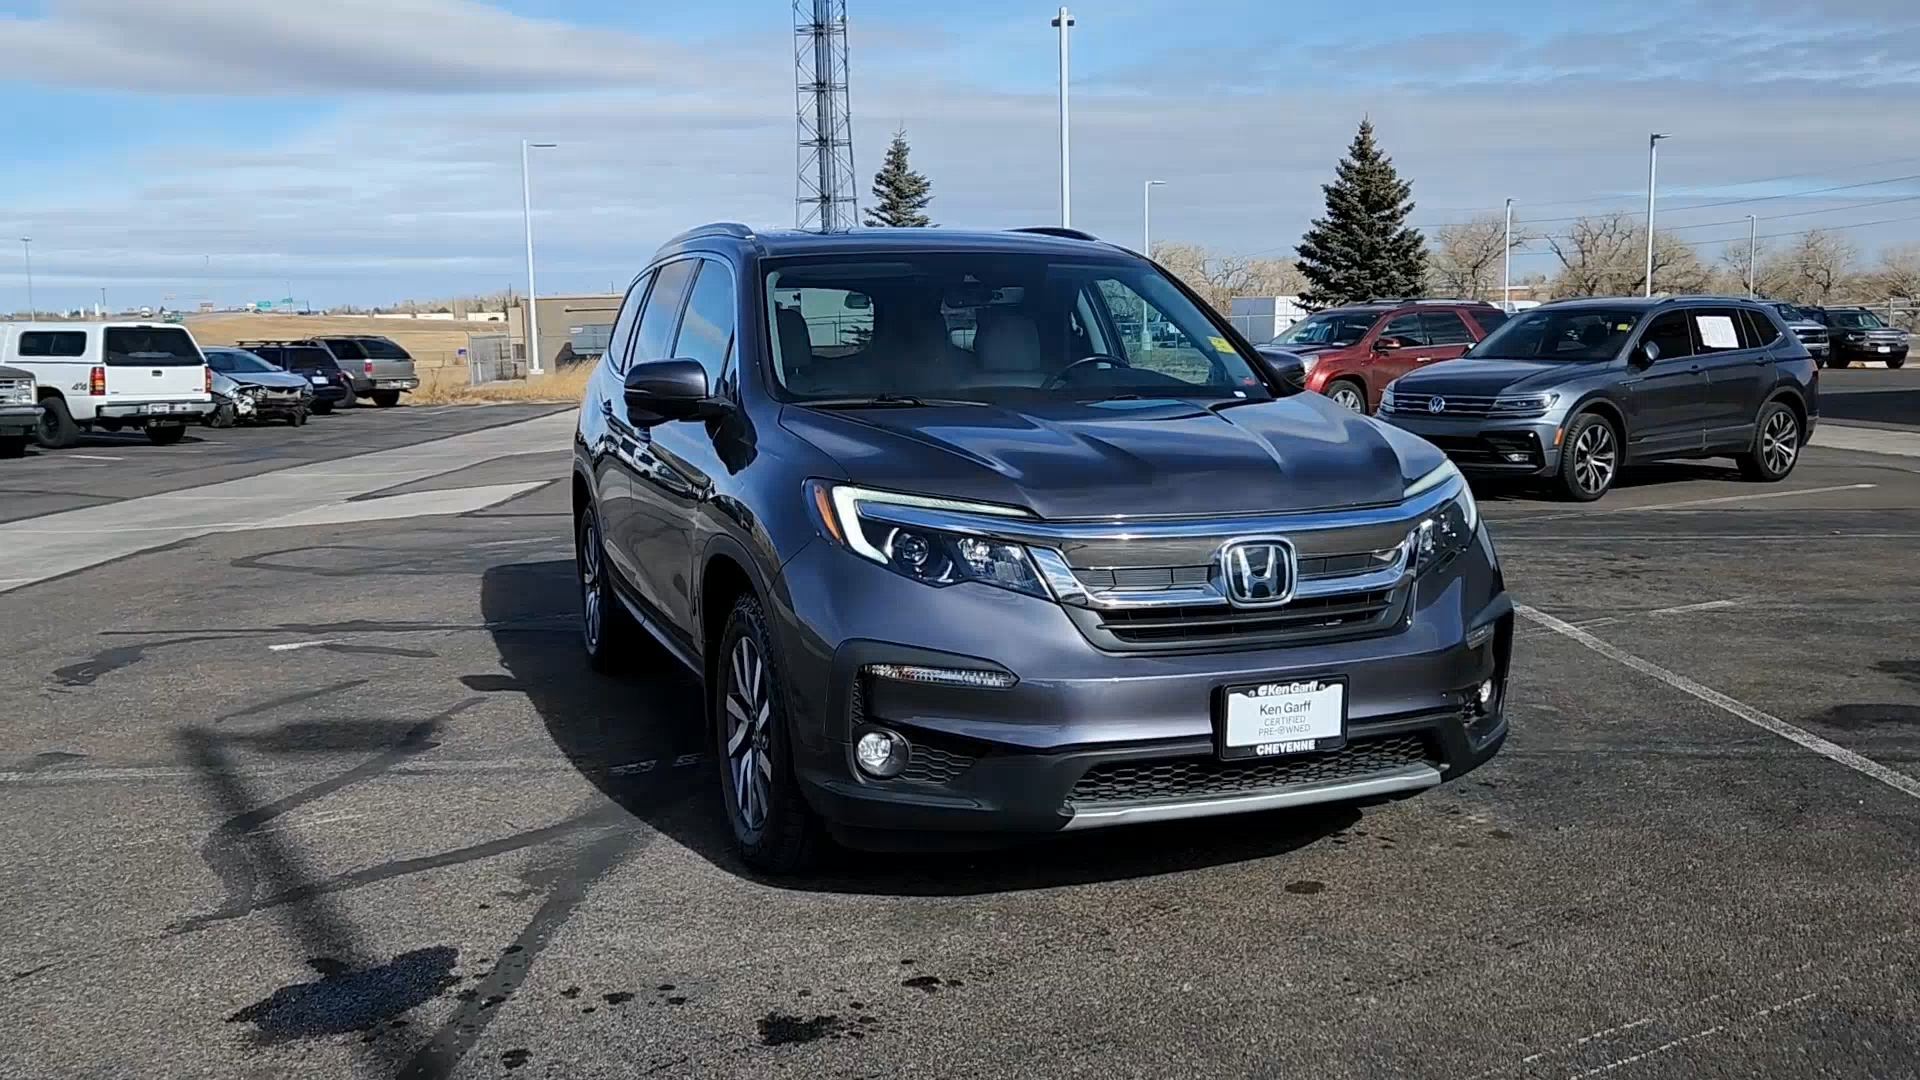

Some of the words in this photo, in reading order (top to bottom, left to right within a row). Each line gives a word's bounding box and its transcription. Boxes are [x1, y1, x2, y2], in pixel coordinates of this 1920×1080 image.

[1268, 684, 1290, 696] Ken
[1290, 680, 1319, 694] Garff
[1260, 703, 1282, 716] Ken
[1284, 700, 1312, 713] Garff
[1264, 715, 1306, 727] CERTIFIED
[1258, 723, 1311, 736] PRE-OWNED
[1256, 739, 1316, 756] CHEYENNE
